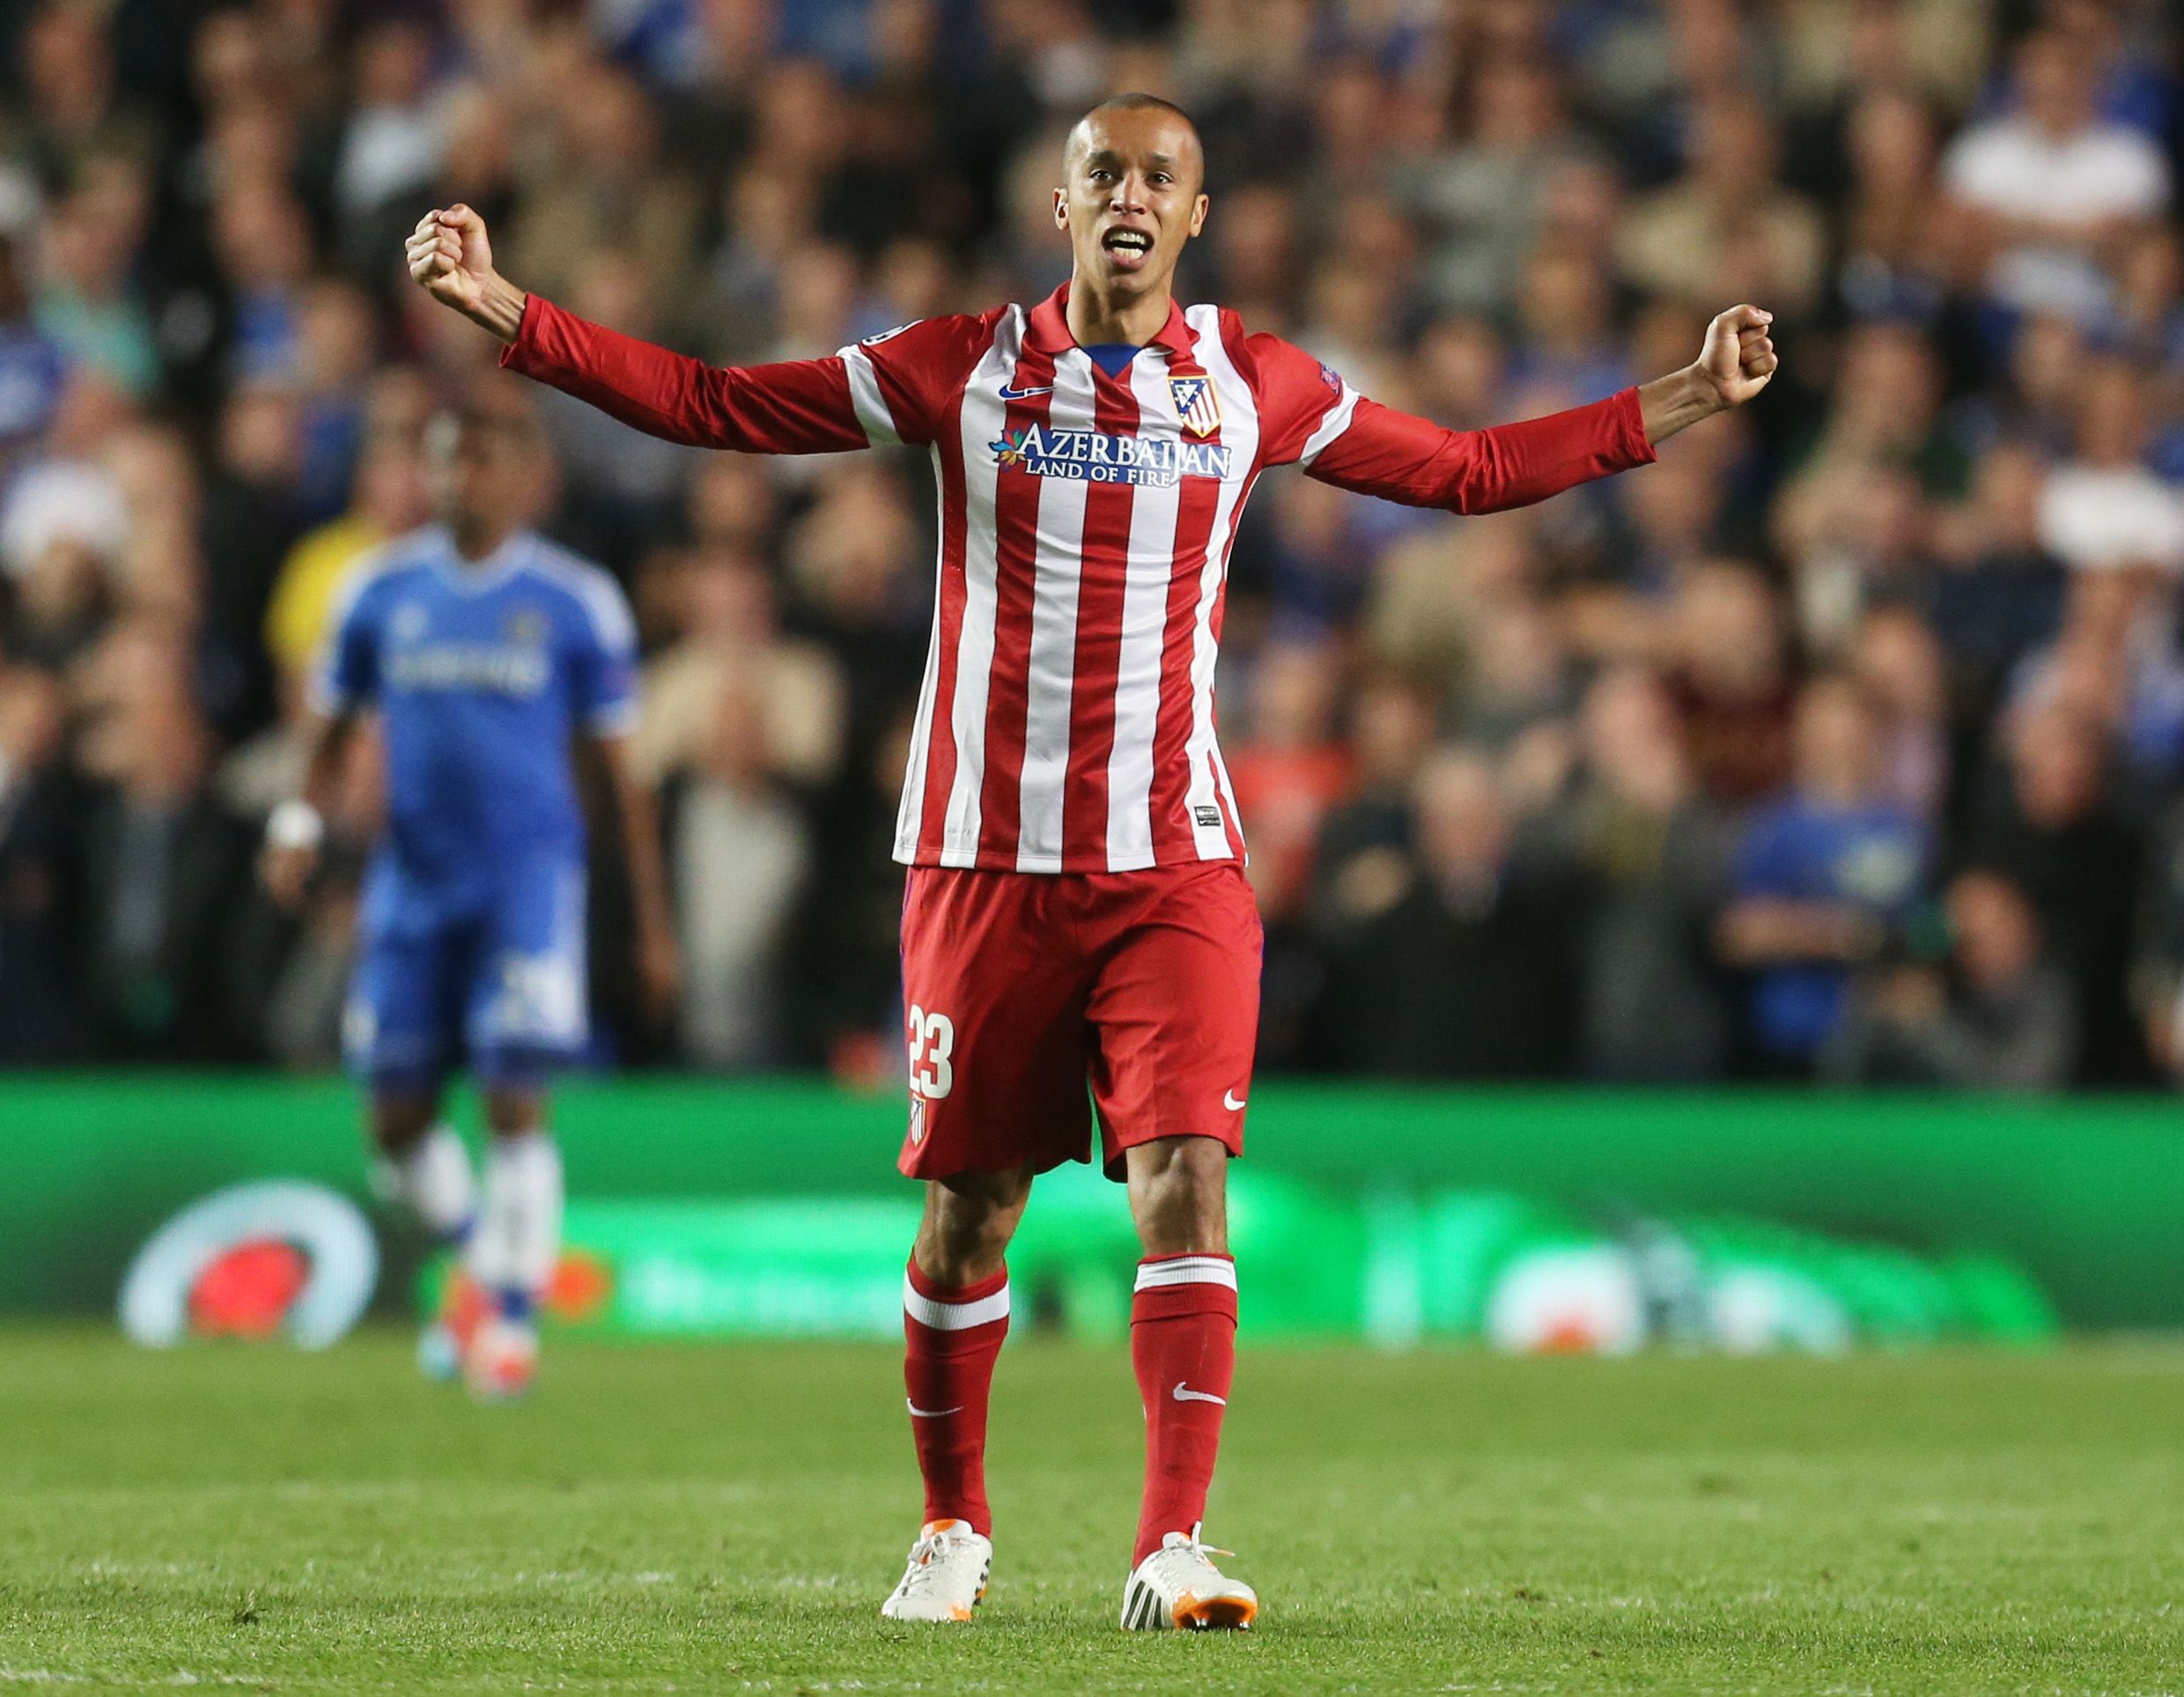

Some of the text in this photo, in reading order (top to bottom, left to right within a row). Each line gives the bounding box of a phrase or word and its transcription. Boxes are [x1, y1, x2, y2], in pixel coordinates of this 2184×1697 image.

[1017, 423, 1230, 482] AZERBAIJAN
[1025, 459, 1170, 485] LAND OF FIRE
[910, 1004, 954, 1098] 23
